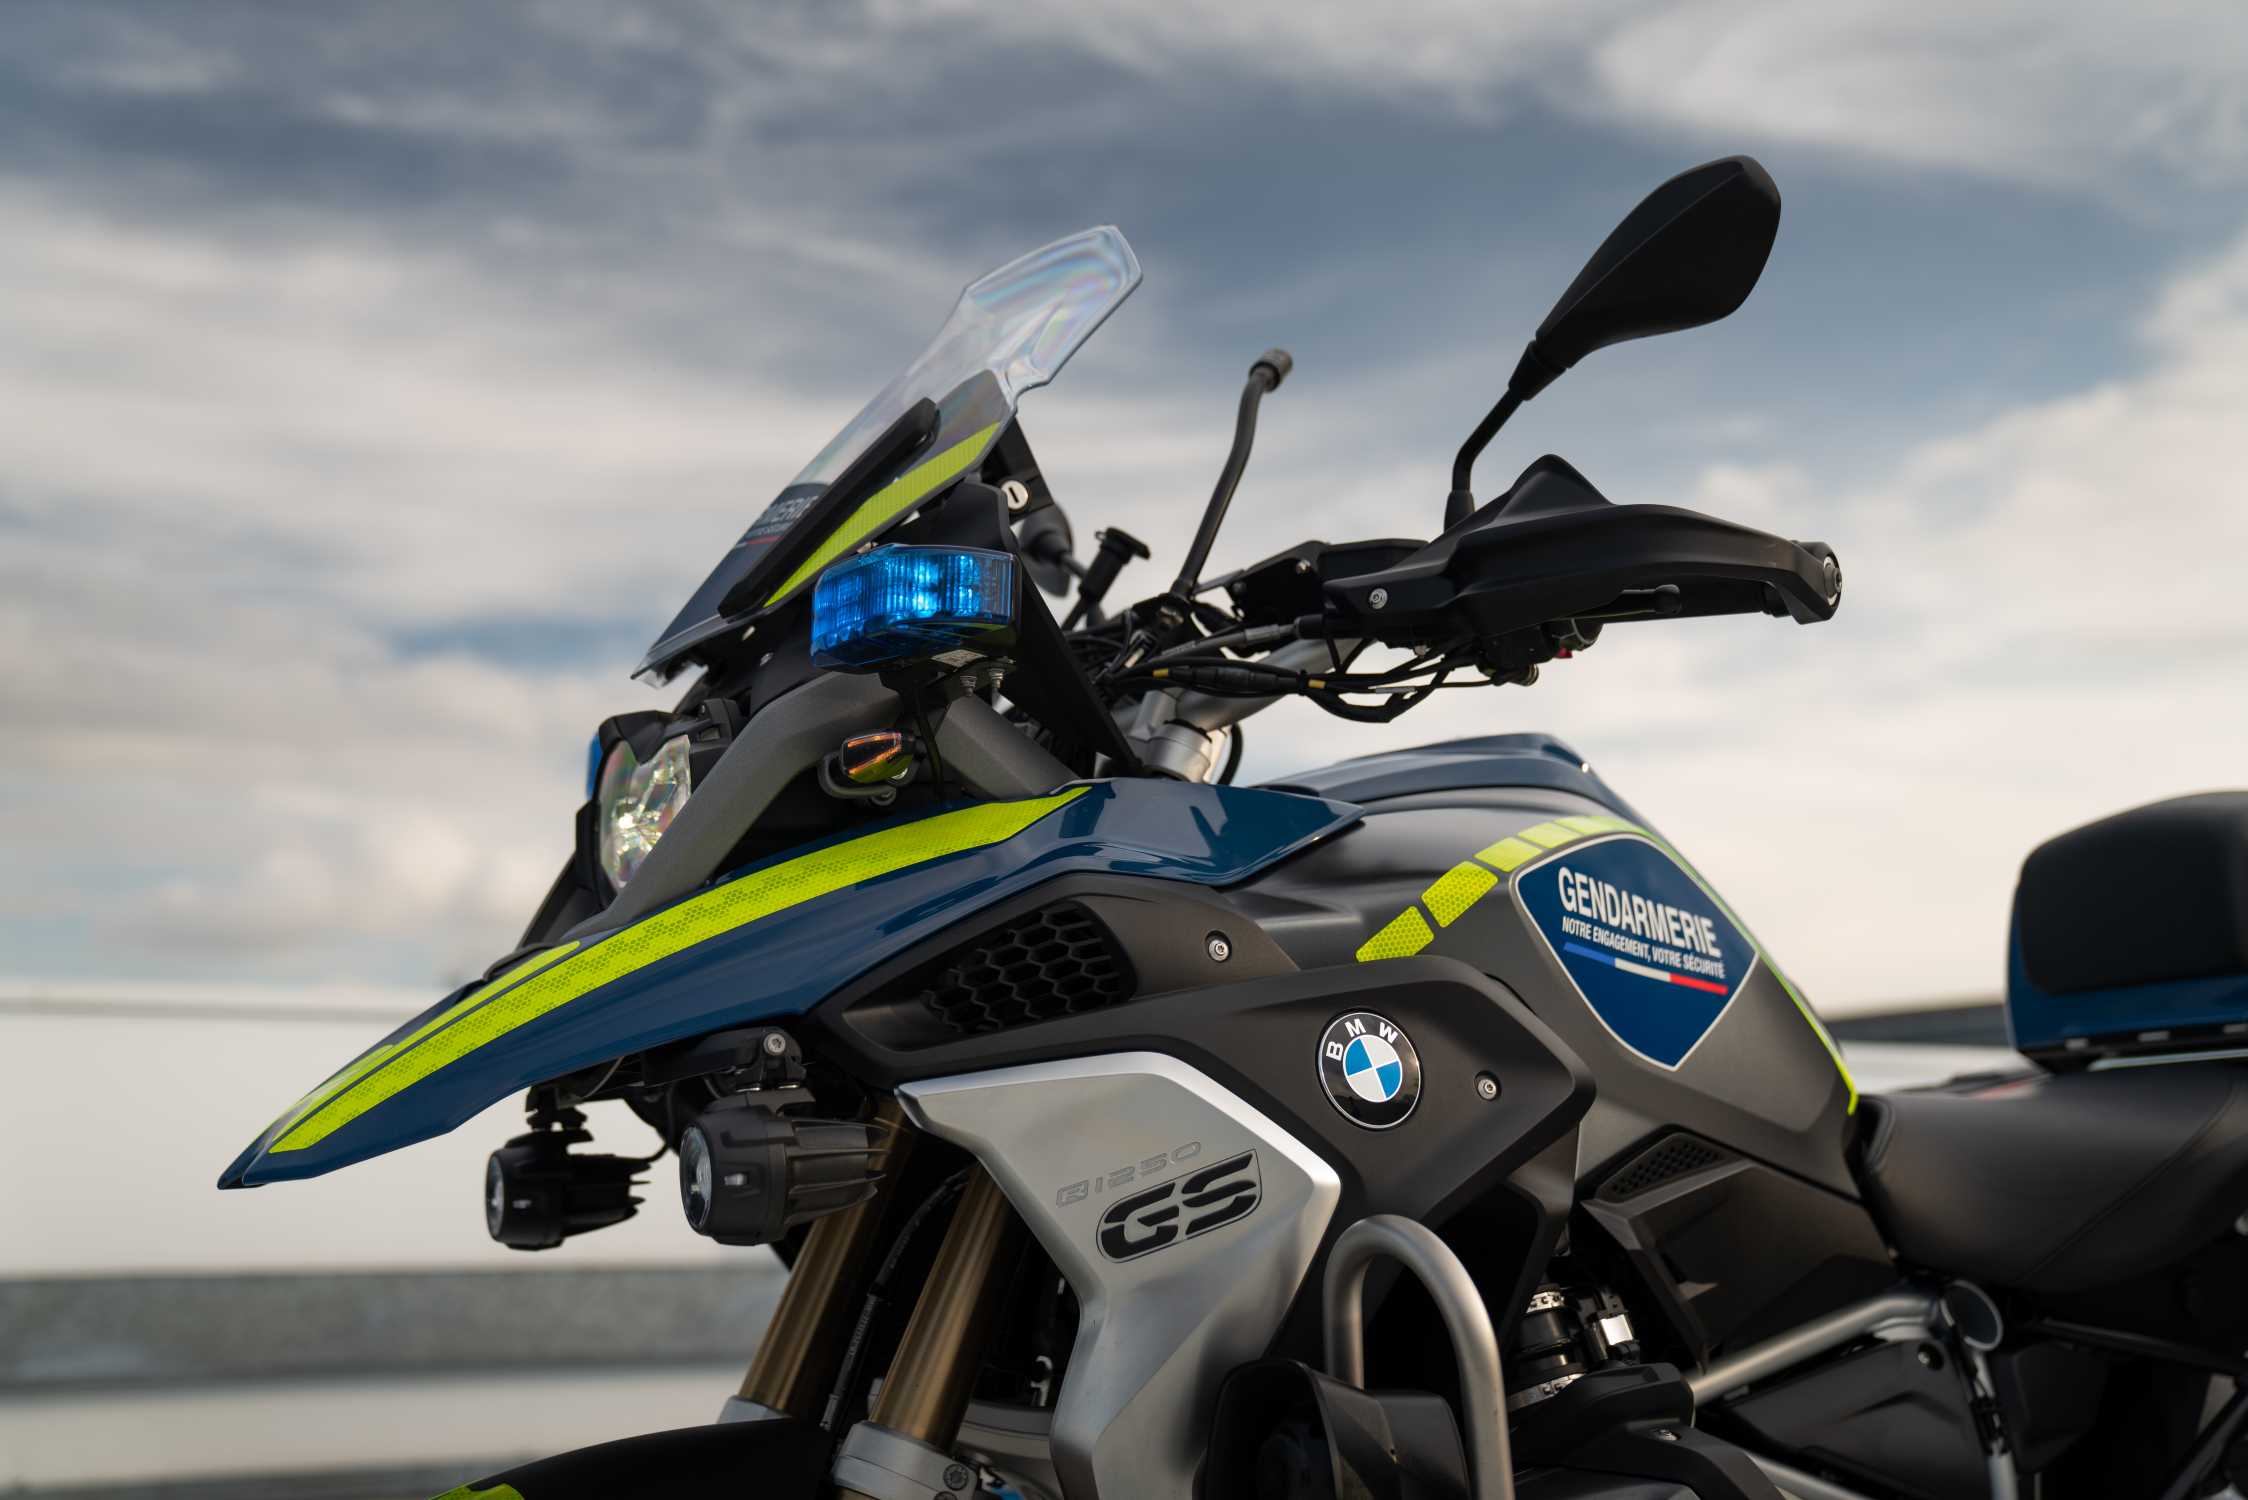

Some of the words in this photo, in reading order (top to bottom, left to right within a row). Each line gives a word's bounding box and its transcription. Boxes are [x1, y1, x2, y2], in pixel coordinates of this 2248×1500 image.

[1558, 866, 1722, 958] GENDARMERIE
[1562, 916, 1592, 940] NOTRE
[1593, 926, 1651, 963] ENGAGEMENT,
[1652, 945, 1681, 968] VOTRE
[1326, 1018, 1398, 1061] BMW
[1100, 1153, 1258, 1258] GS
